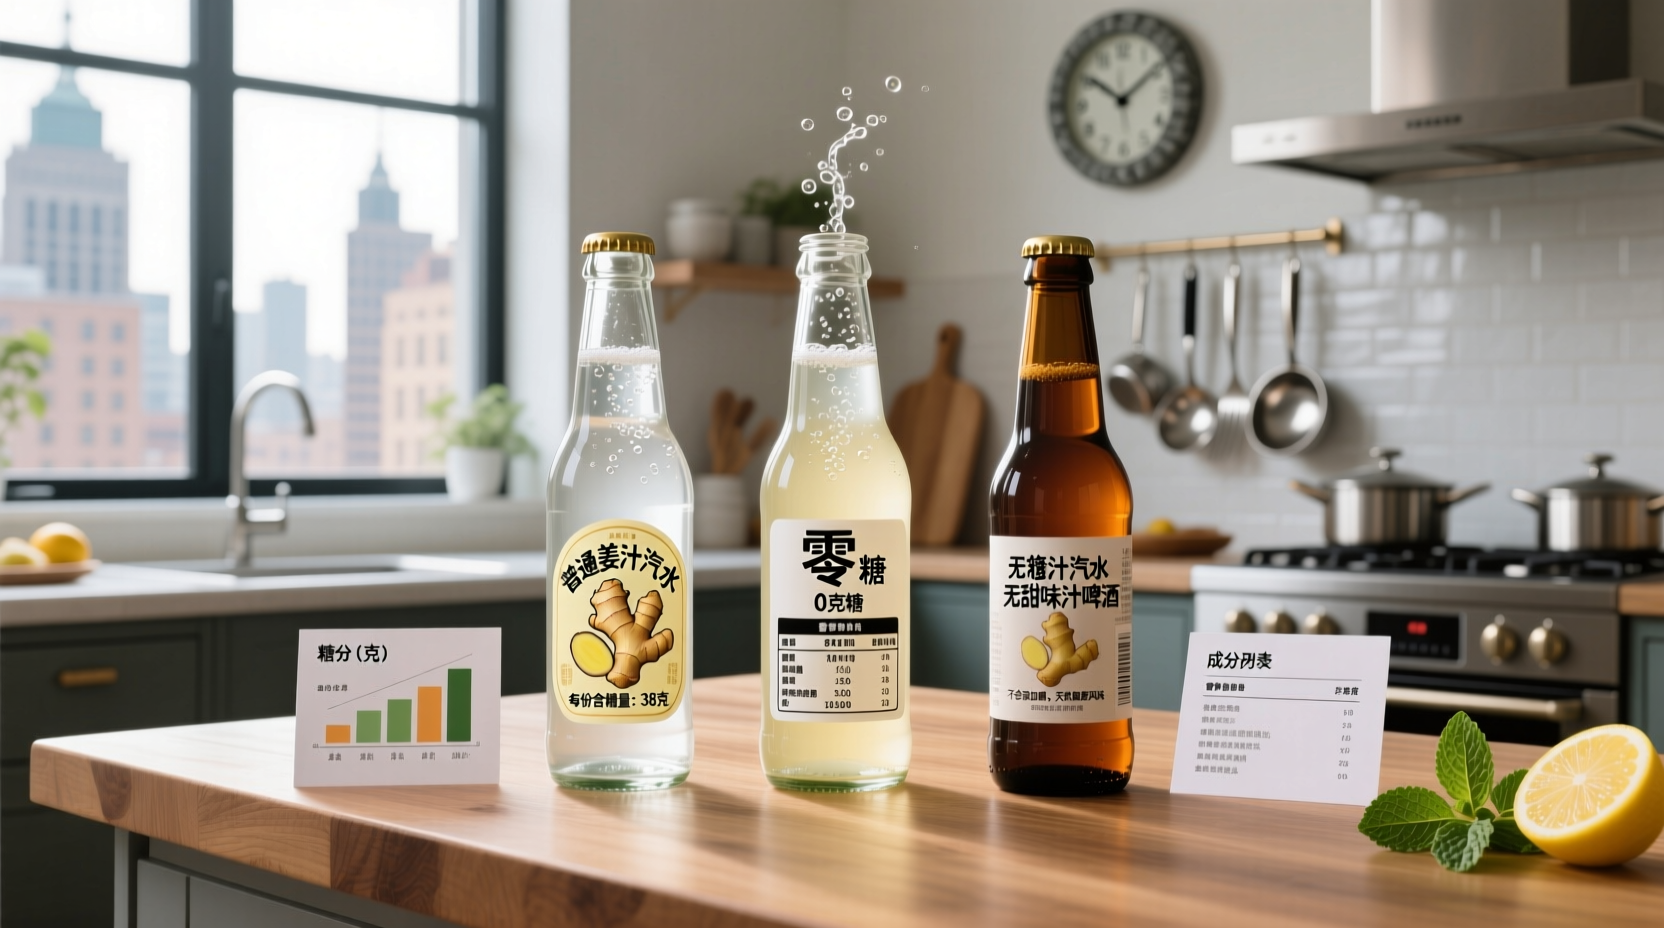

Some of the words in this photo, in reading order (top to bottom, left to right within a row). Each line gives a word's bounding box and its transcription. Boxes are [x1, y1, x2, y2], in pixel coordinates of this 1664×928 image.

[561, 543, 680, 593] 普通姜汁汽水
[814, 592, 864, 613] 0克糖
[1003, 583, 1120, 609] 无甜味汁啤酒
